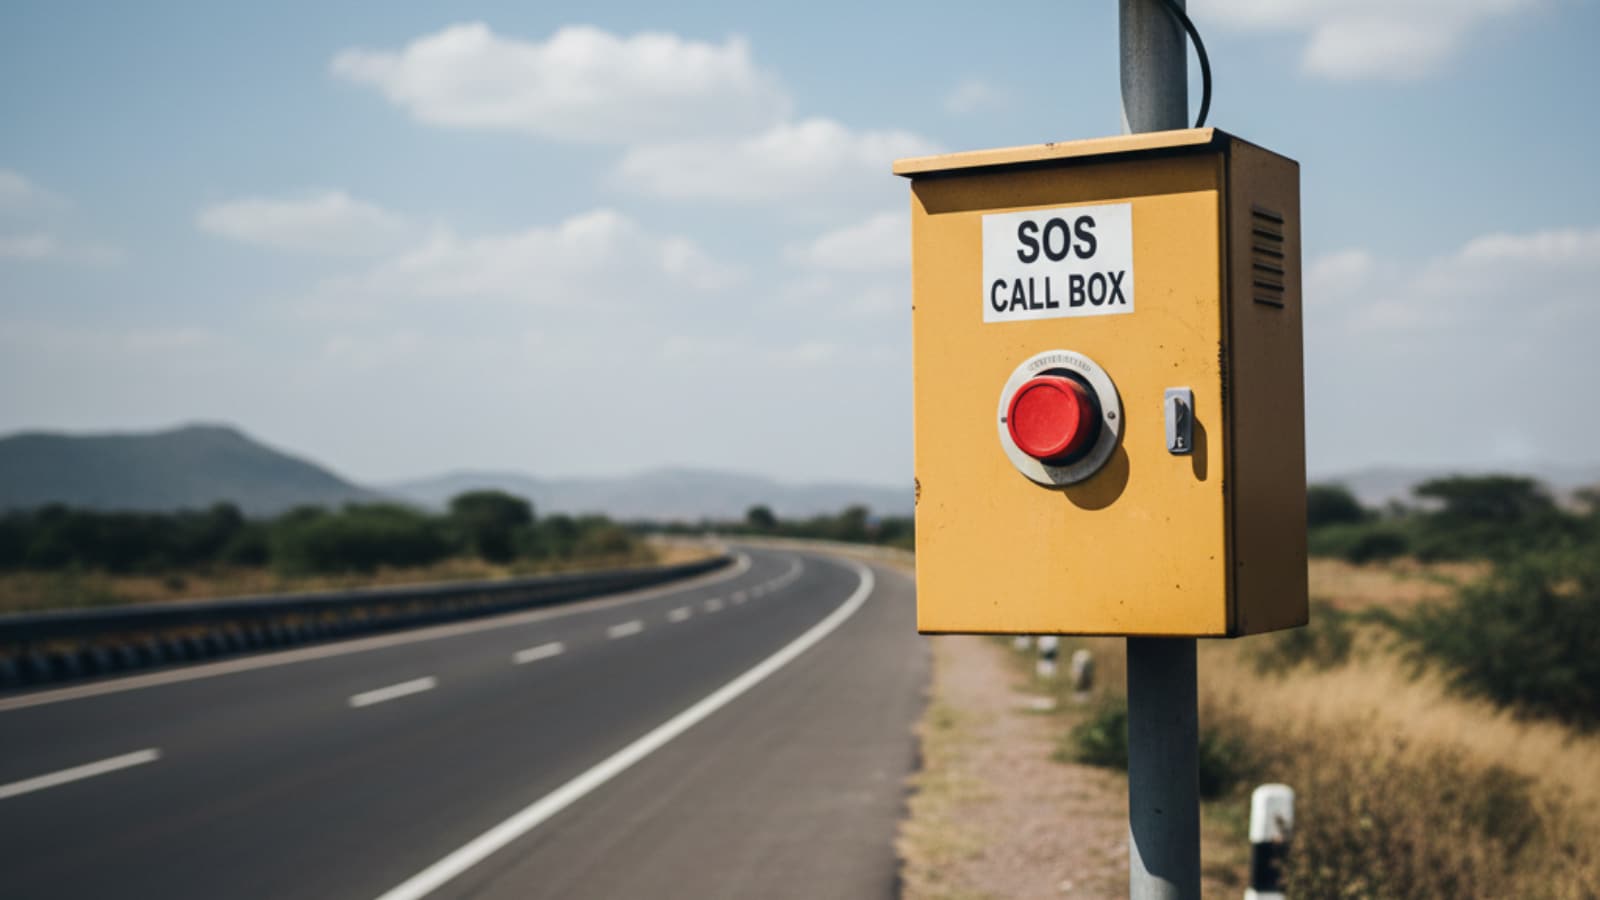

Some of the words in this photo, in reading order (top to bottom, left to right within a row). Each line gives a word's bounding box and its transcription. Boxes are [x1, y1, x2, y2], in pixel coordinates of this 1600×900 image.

[1017, 215, 1097, 263] SOS
[991, 276, 1059, 312] CALL
[1069, 270, 1126, 307] BOX
